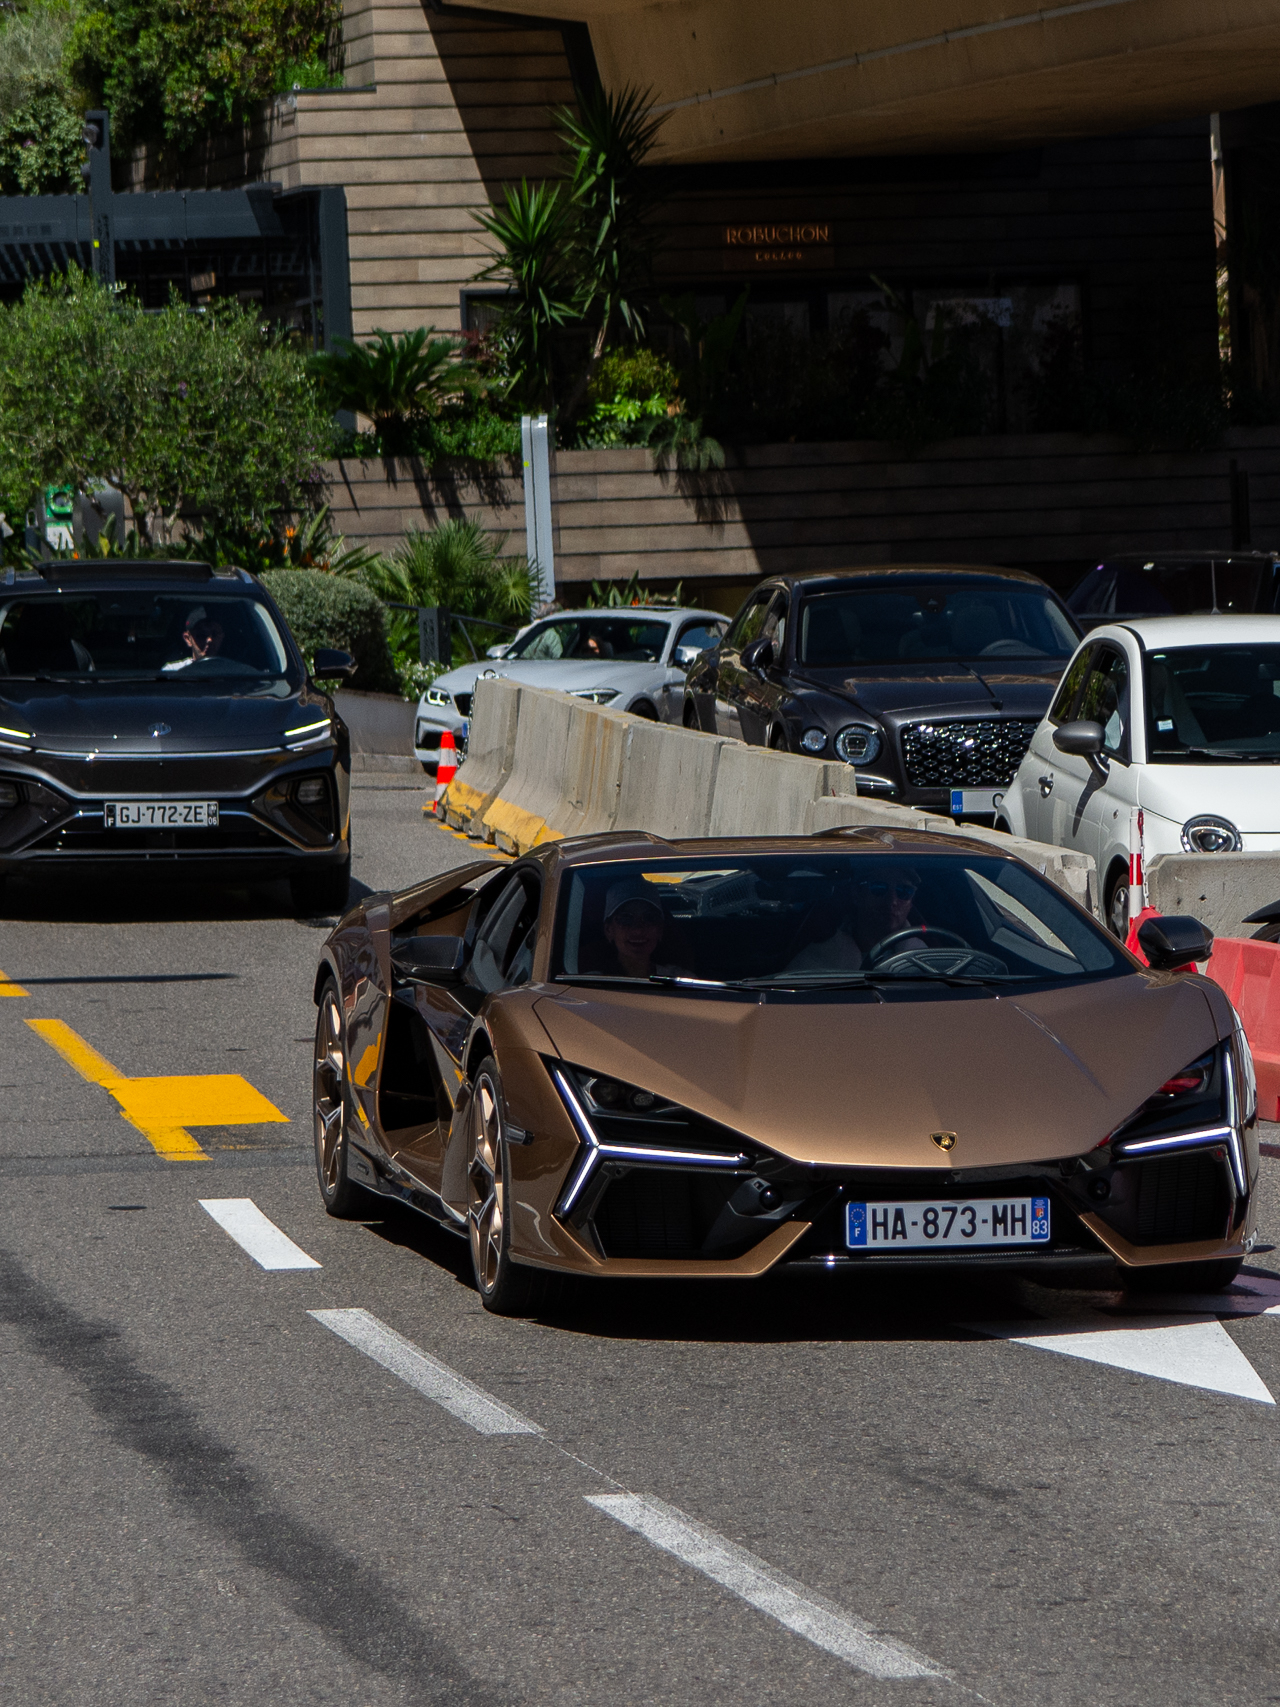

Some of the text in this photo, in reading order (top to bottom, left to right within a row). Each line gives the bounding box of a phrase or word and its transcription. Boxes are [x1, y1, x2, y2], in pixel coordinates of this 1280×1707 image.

[726, 225, 829, 244] ROBUCHON
[119, 805, 204, 824] GJ-772-ZE
[208, 816, 217, 825] 06
[854, 1227, 861, 1238] F
[871, 1203, 1028, 1241] HA-873-MH
[1032, 1219, 1049, 1236] 83
